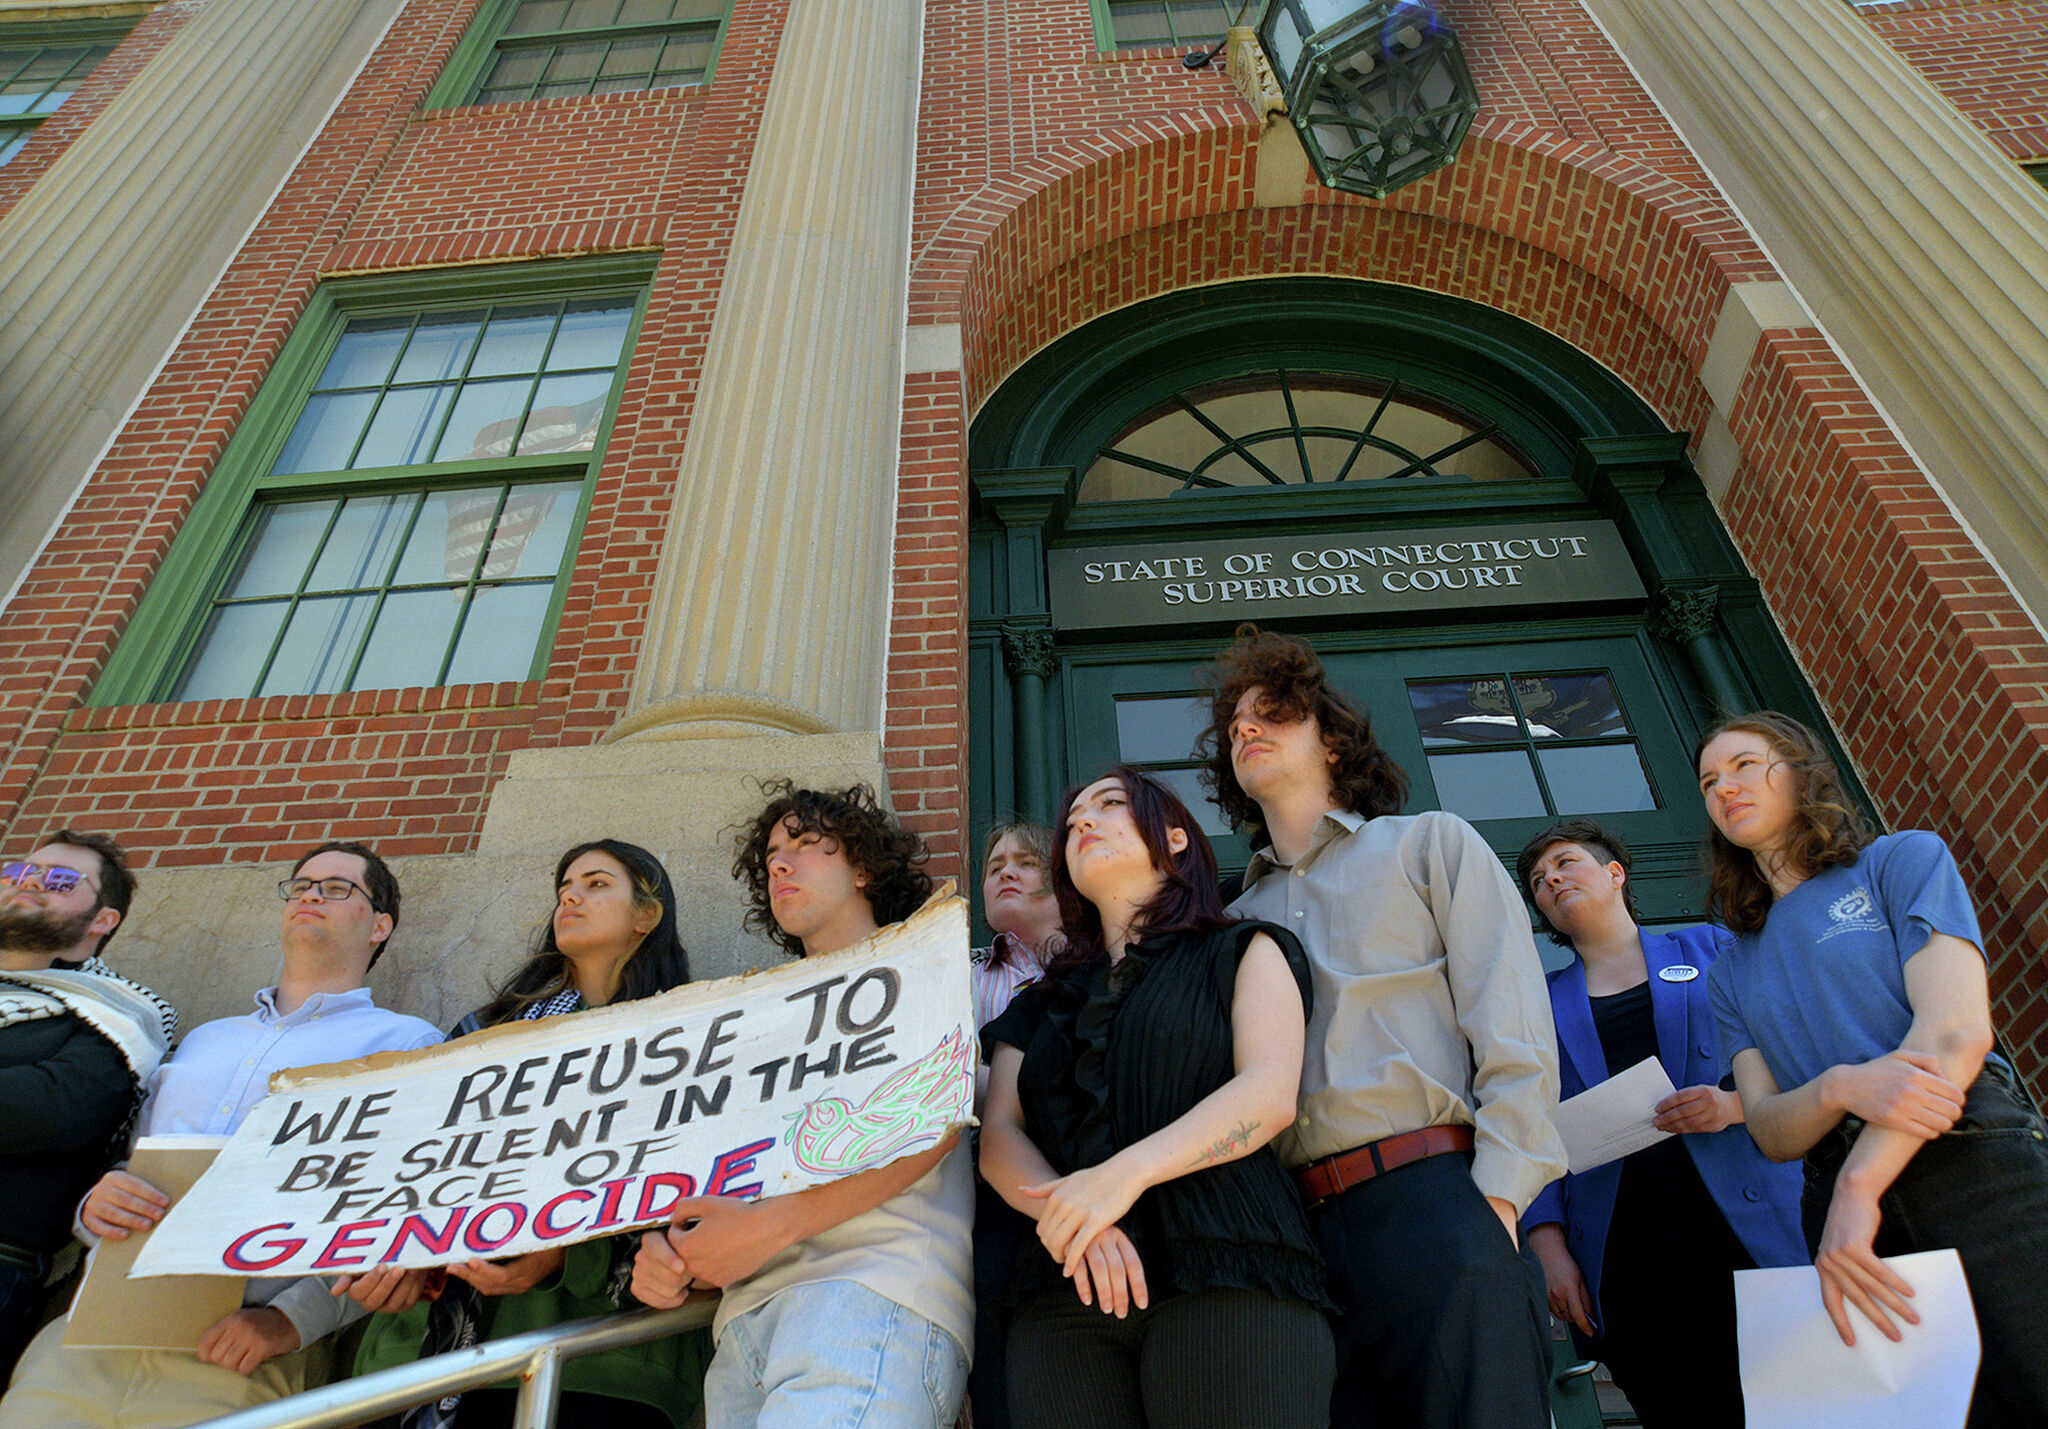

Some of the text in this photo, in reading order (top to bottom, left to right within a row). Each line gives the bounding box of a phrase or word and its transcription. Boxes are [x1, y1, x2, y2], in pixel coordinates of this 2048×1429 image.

[1083, 535, 1588, 584] STATE OF CONNECTICUT
[1163, 564, 1524, 605] SUPERIOR COURT
[271, 966, 902, 1147] WE REFUSE TO
[276, 1025, 898, 1193] BE SILENT IN THE
[221, 1136, 777, 1272] GENOCIDE
[318, 1133, 682, 1224] FACE OF
